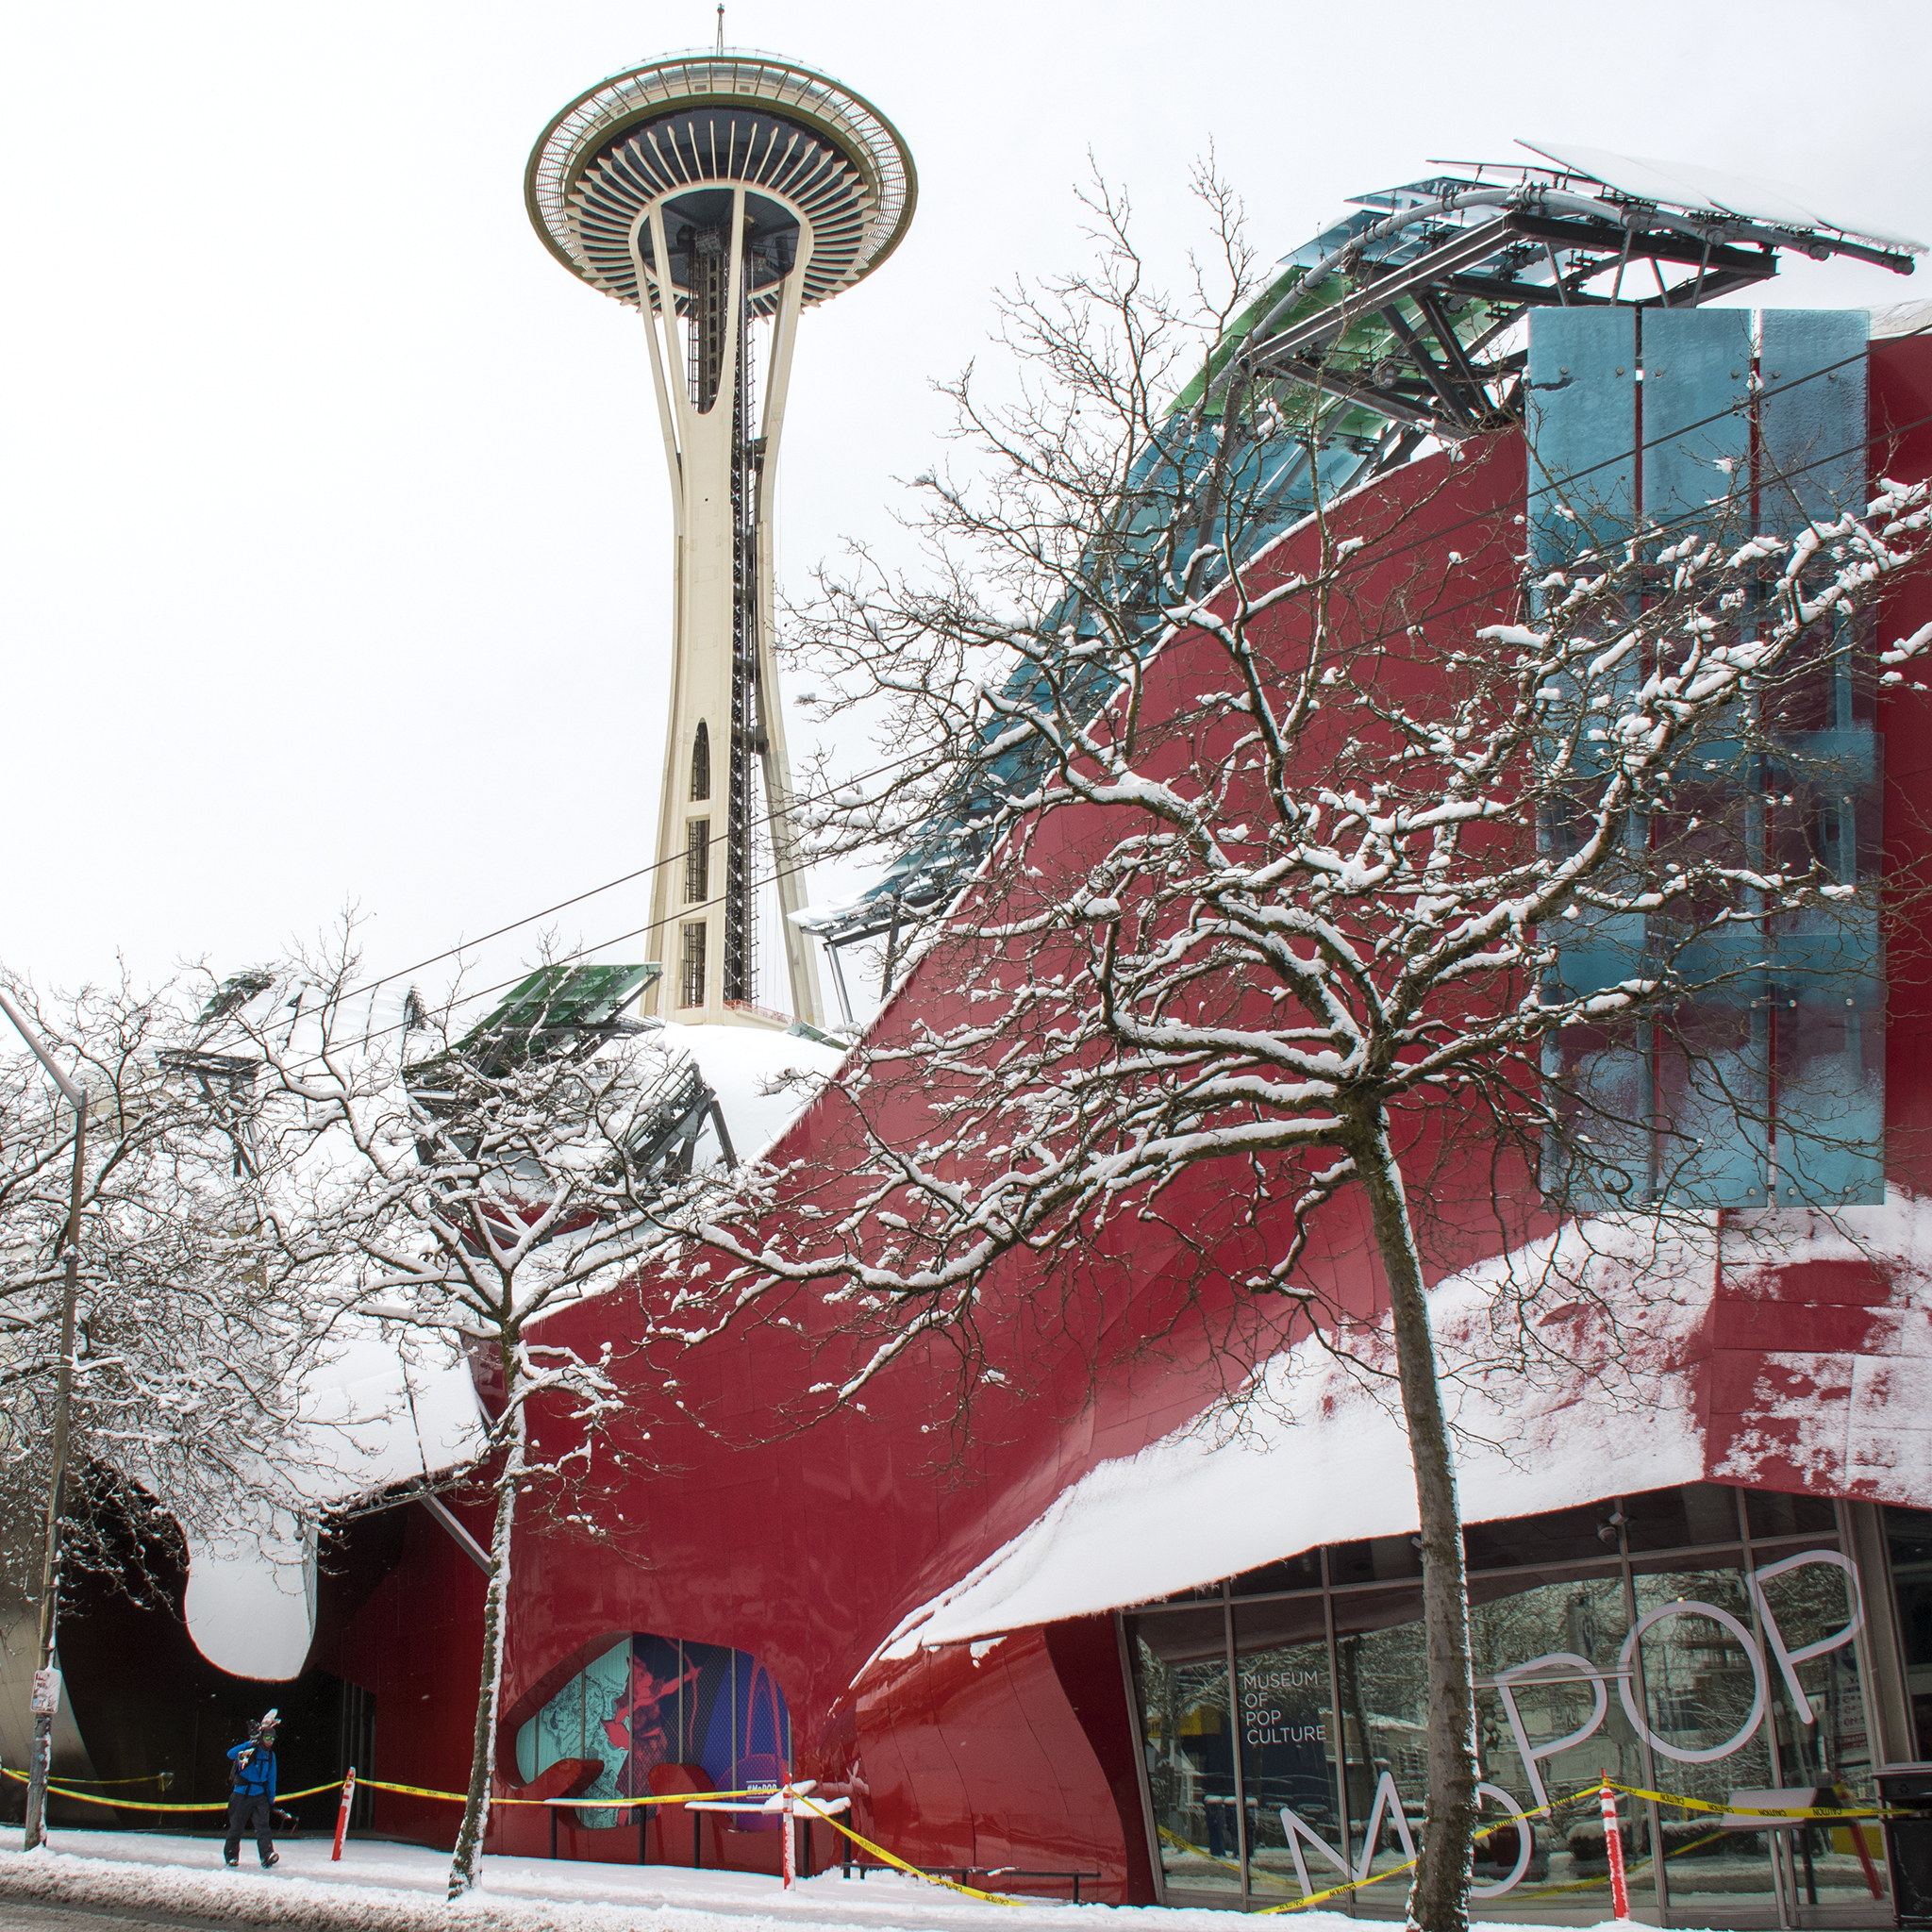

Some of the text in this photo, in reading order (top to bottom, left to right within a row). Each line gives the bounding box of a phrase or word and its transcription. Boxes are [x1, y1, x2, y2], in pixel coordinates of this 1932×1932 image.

[1243, 1670, 1319, 1690] MUSEUM
[1244, 1691, 1269, 1709] OF
[1245, 1709, 1282, 1726] POP
[1246, 1724, 1327, 1744] CULTURE
[1660, 1793, 1685, 1806] CAUTION
[983, 1893, 1009, 1906] CAUTION
